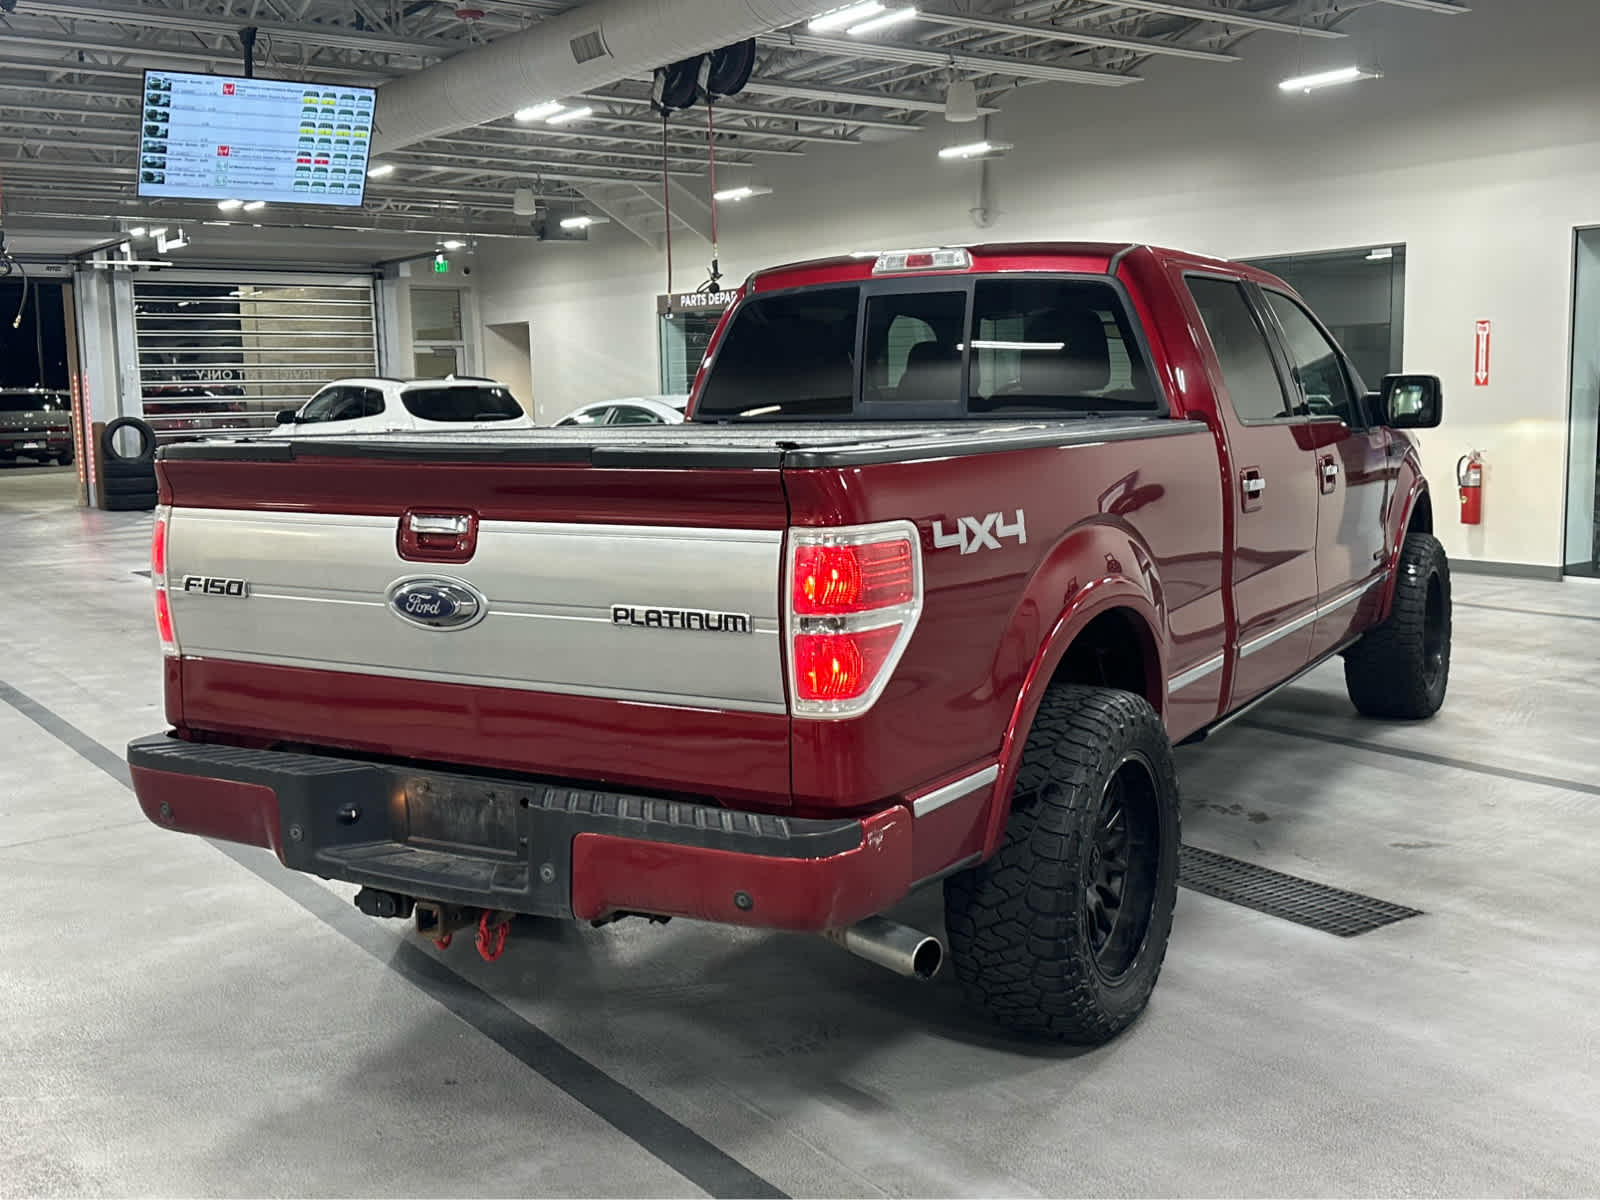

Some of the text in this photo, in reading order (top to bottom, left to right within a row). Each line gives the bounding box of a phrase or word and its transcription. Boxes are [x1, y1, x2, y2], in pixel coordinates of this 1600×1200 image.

[680, 293, 707, 307] PARTS
[932, 509, 1027, 555] 4X4
[184, 576, 244, 597] F-150
[405, 592, 441, 615] Ford
[613, 606, 748, 633] PLATINUM
